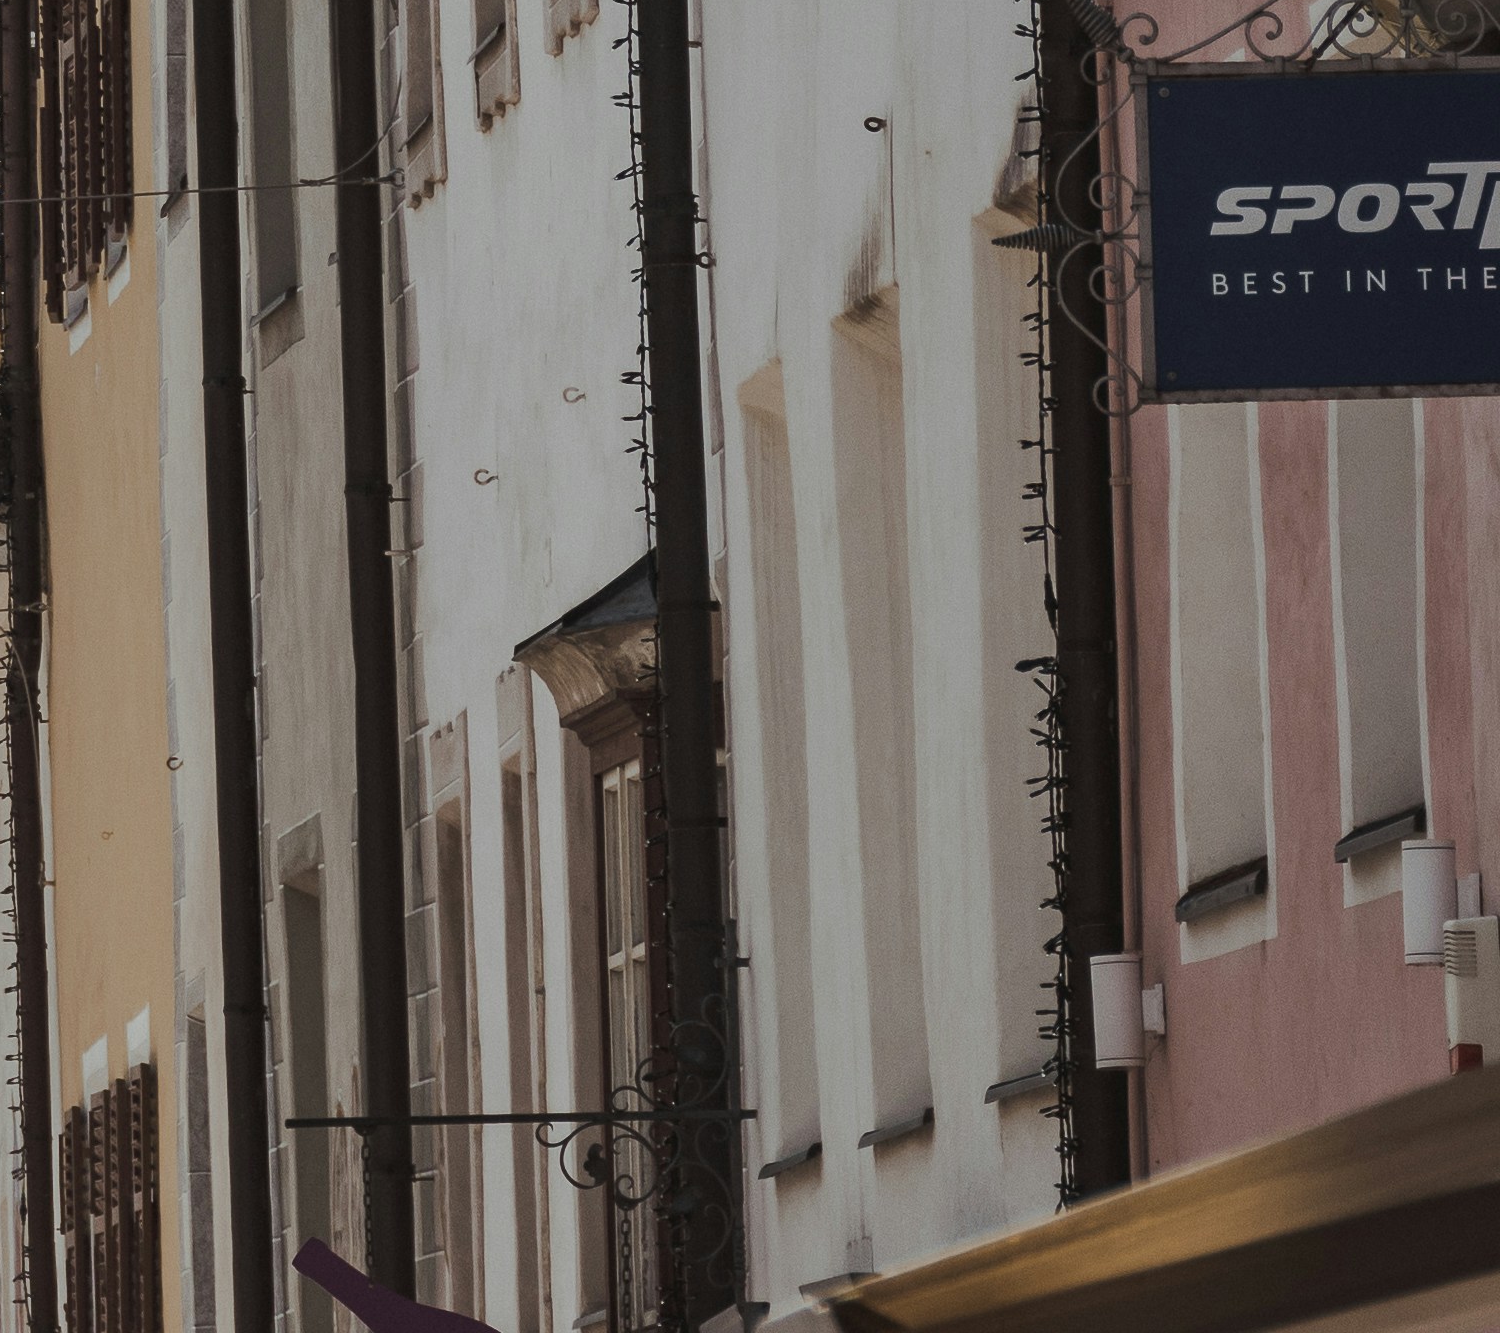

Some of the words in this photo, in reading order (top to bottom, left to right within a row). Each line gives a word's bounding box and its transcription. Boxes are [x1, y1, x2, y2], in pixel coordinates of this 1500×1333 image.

[1209, 161, 1500, 250] SPORT
[1212, 270, 1315, 296] BEST
[1345, 268, 1387, 293] IN
[1417, 266, 1498, 291] THE
